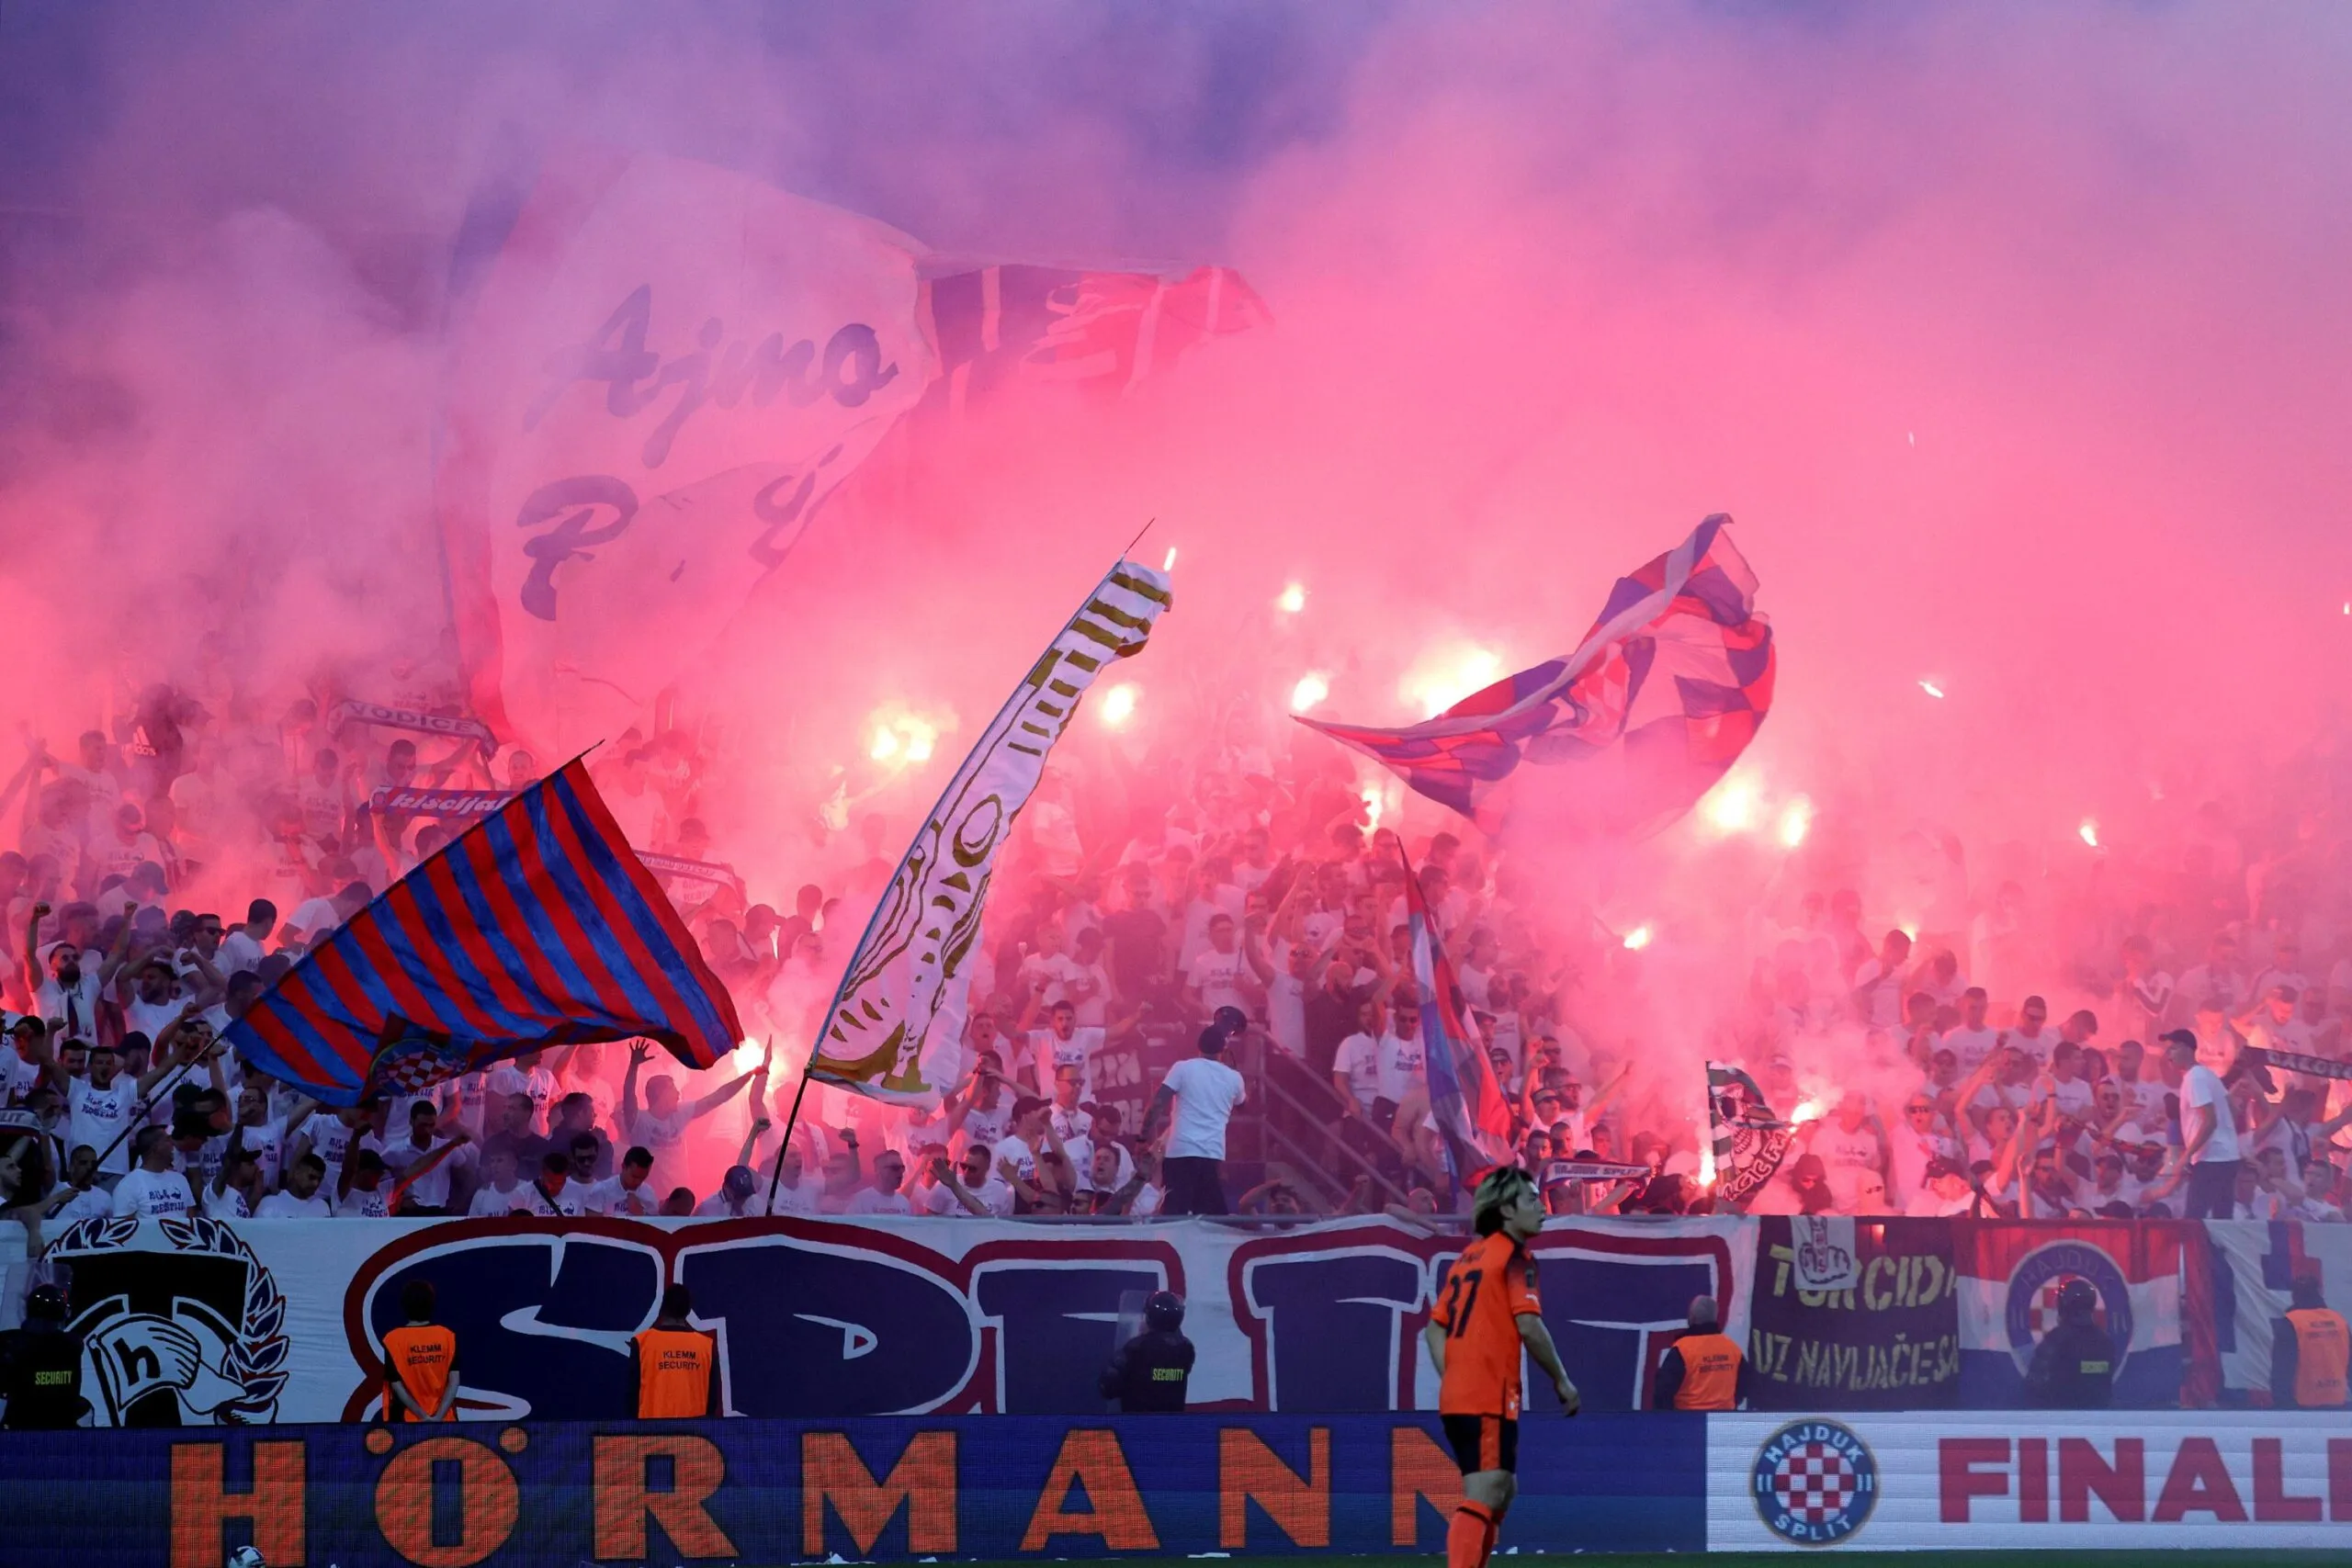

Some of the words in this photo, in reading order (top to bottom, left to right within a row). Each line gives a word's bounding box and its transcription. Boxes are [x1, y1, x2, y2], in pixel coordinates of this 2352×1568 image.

[523, 283, 899, 469] Ajmo
[349, 702, 474, 732] VODICE
[410, 1344, 442, 1354] KLEMM
[663, 1350, 696, 1359] KLEMM
[407, 1355, 446, 1366] SECURITY
[659, 1360, 700, 1371] SECURITY
[35, 1371, 73, 1385] SECURITY
[1152, 1368, 1184, 1382] SECURITY
[1764, 1425, 1864, 1463] HAJDUK
[171, 1427, 1499, 1568] HÖRMANN
[1773, 1514, 1851, 1540] SPLIT
